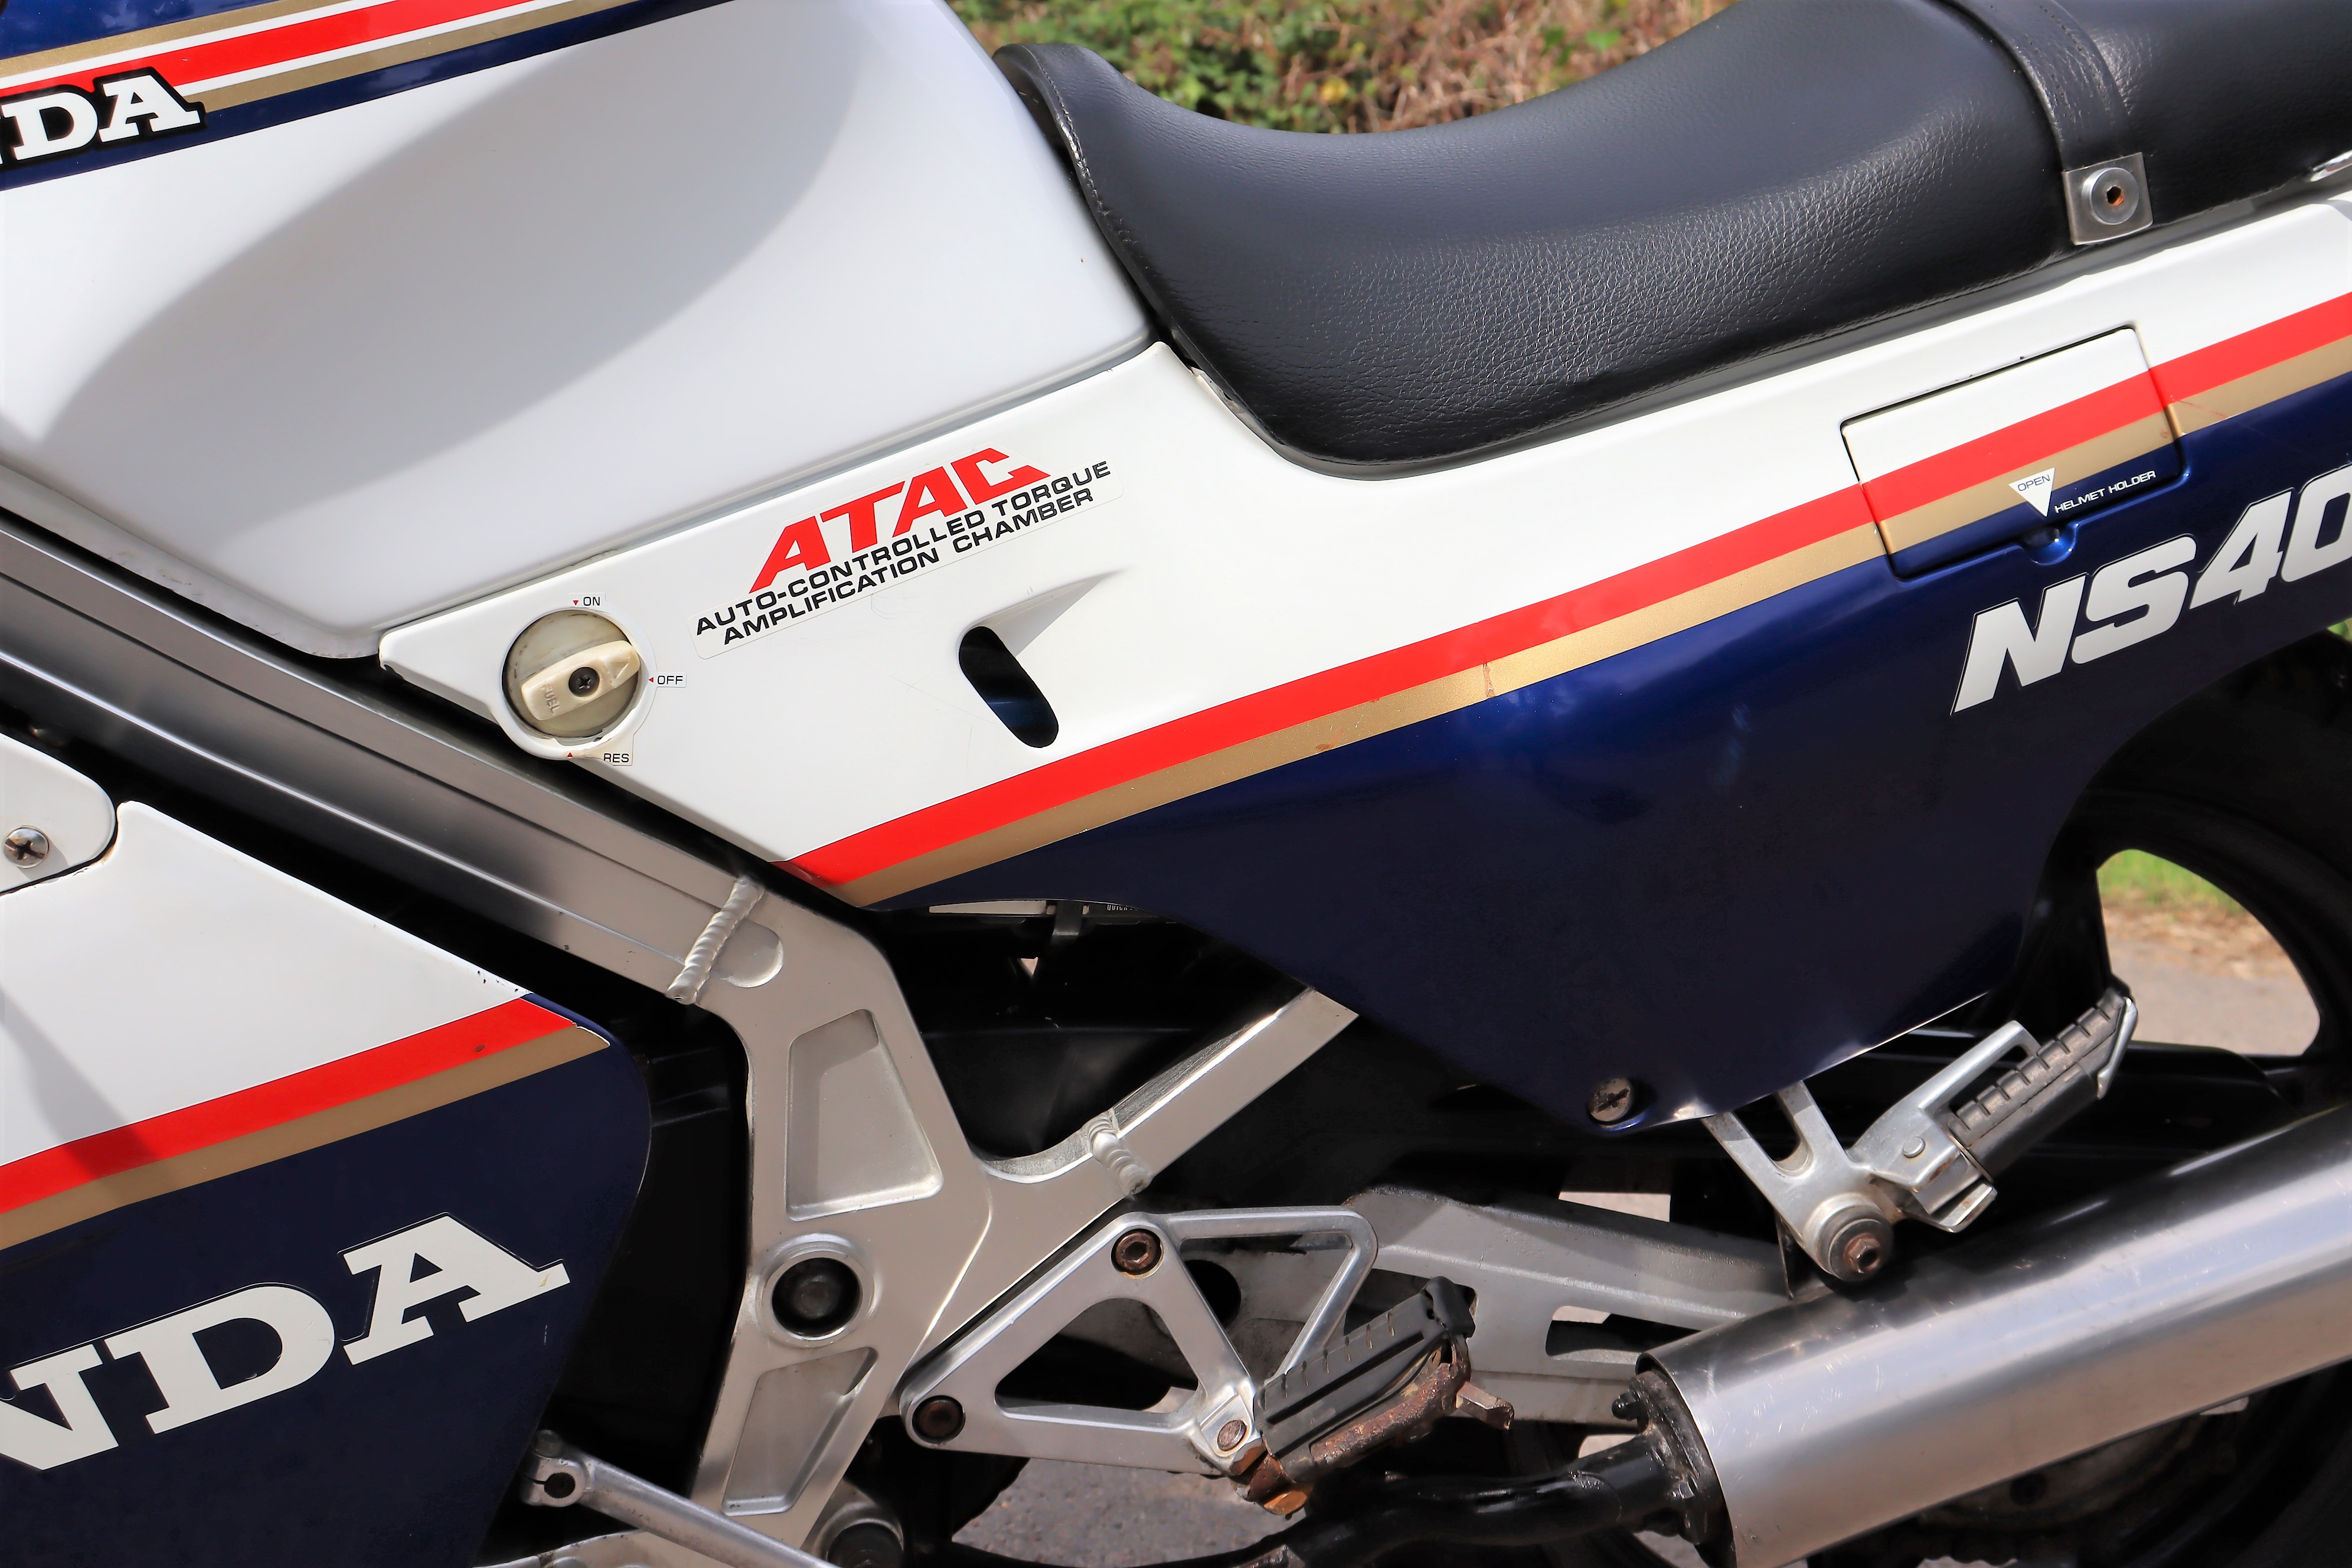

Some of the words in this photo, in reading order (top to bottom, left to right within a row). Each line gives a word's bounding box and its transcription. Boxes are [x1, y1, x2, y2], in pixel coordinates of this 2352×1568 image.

[0, 74, 201, 164] DA
[2017, 473, 2051, 492] OPEN
[2054, 488, 2106, 514] HELMET
[2108, 470, 2156, 494] HOLDER
[749, 447, 1051, 594] ATAC
[696, 509, 985, 636] AUTO-CONTROLLED
[991, 460, 1110, 514] TORQUE
[724, 547, 940, 645] AMPLIFICATION
[952, 488, 1093, 553] CHAMBER
[583, 596, 600, 606] ON
[657, 675, 684, 685] OFF
[603, 753, 629, 763] RES
